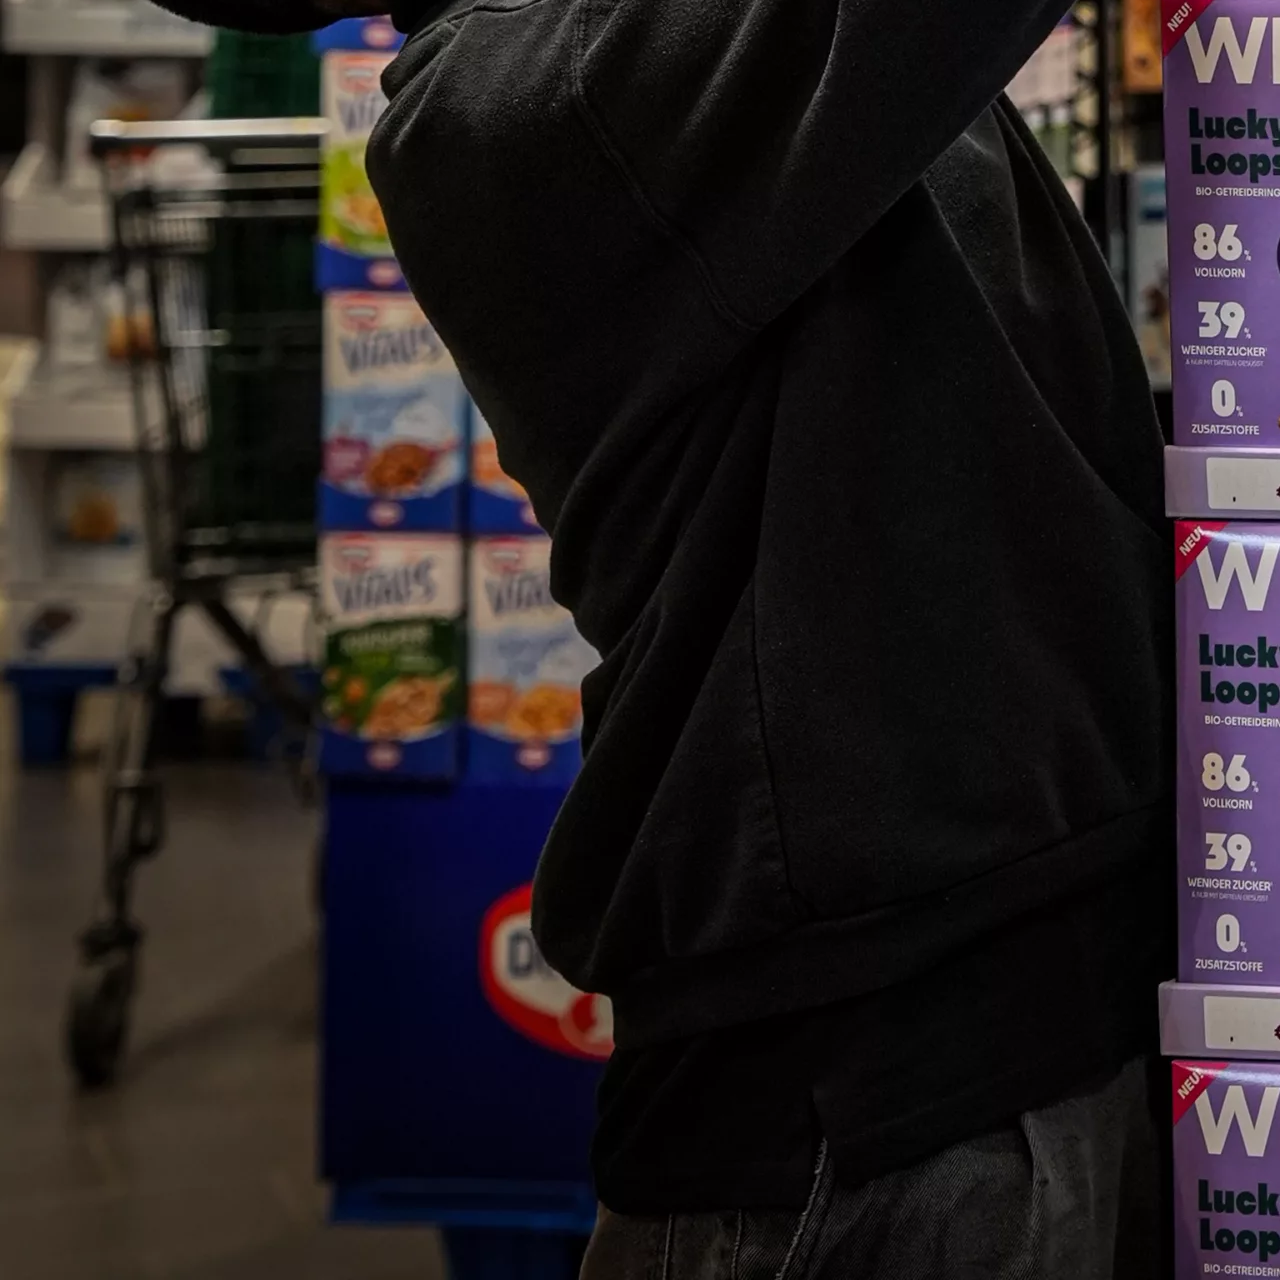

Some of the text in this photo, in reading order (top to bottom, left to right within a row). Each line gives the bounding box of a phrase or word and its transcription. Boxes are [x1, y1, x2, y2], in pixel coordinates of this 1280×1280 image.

[1166, 2, 1193, 32] NEU!
[1194, 268, 1245, 279] VOLLKORN
[1181, 345, 1225, 356] WENIGER
[1192, 424, 1260, 435] ZUSATZSTOFFE
[1179, 525, 1205, 557] NEU!
[1202, 798, 1253, 810] VOLLKORN
[1187, 877, 1230, 890] WENIGER
[1195, 958, 1263, 972] ZUSATZSTOFFE
[1178, 1069, 1203, 1100] NEU!
